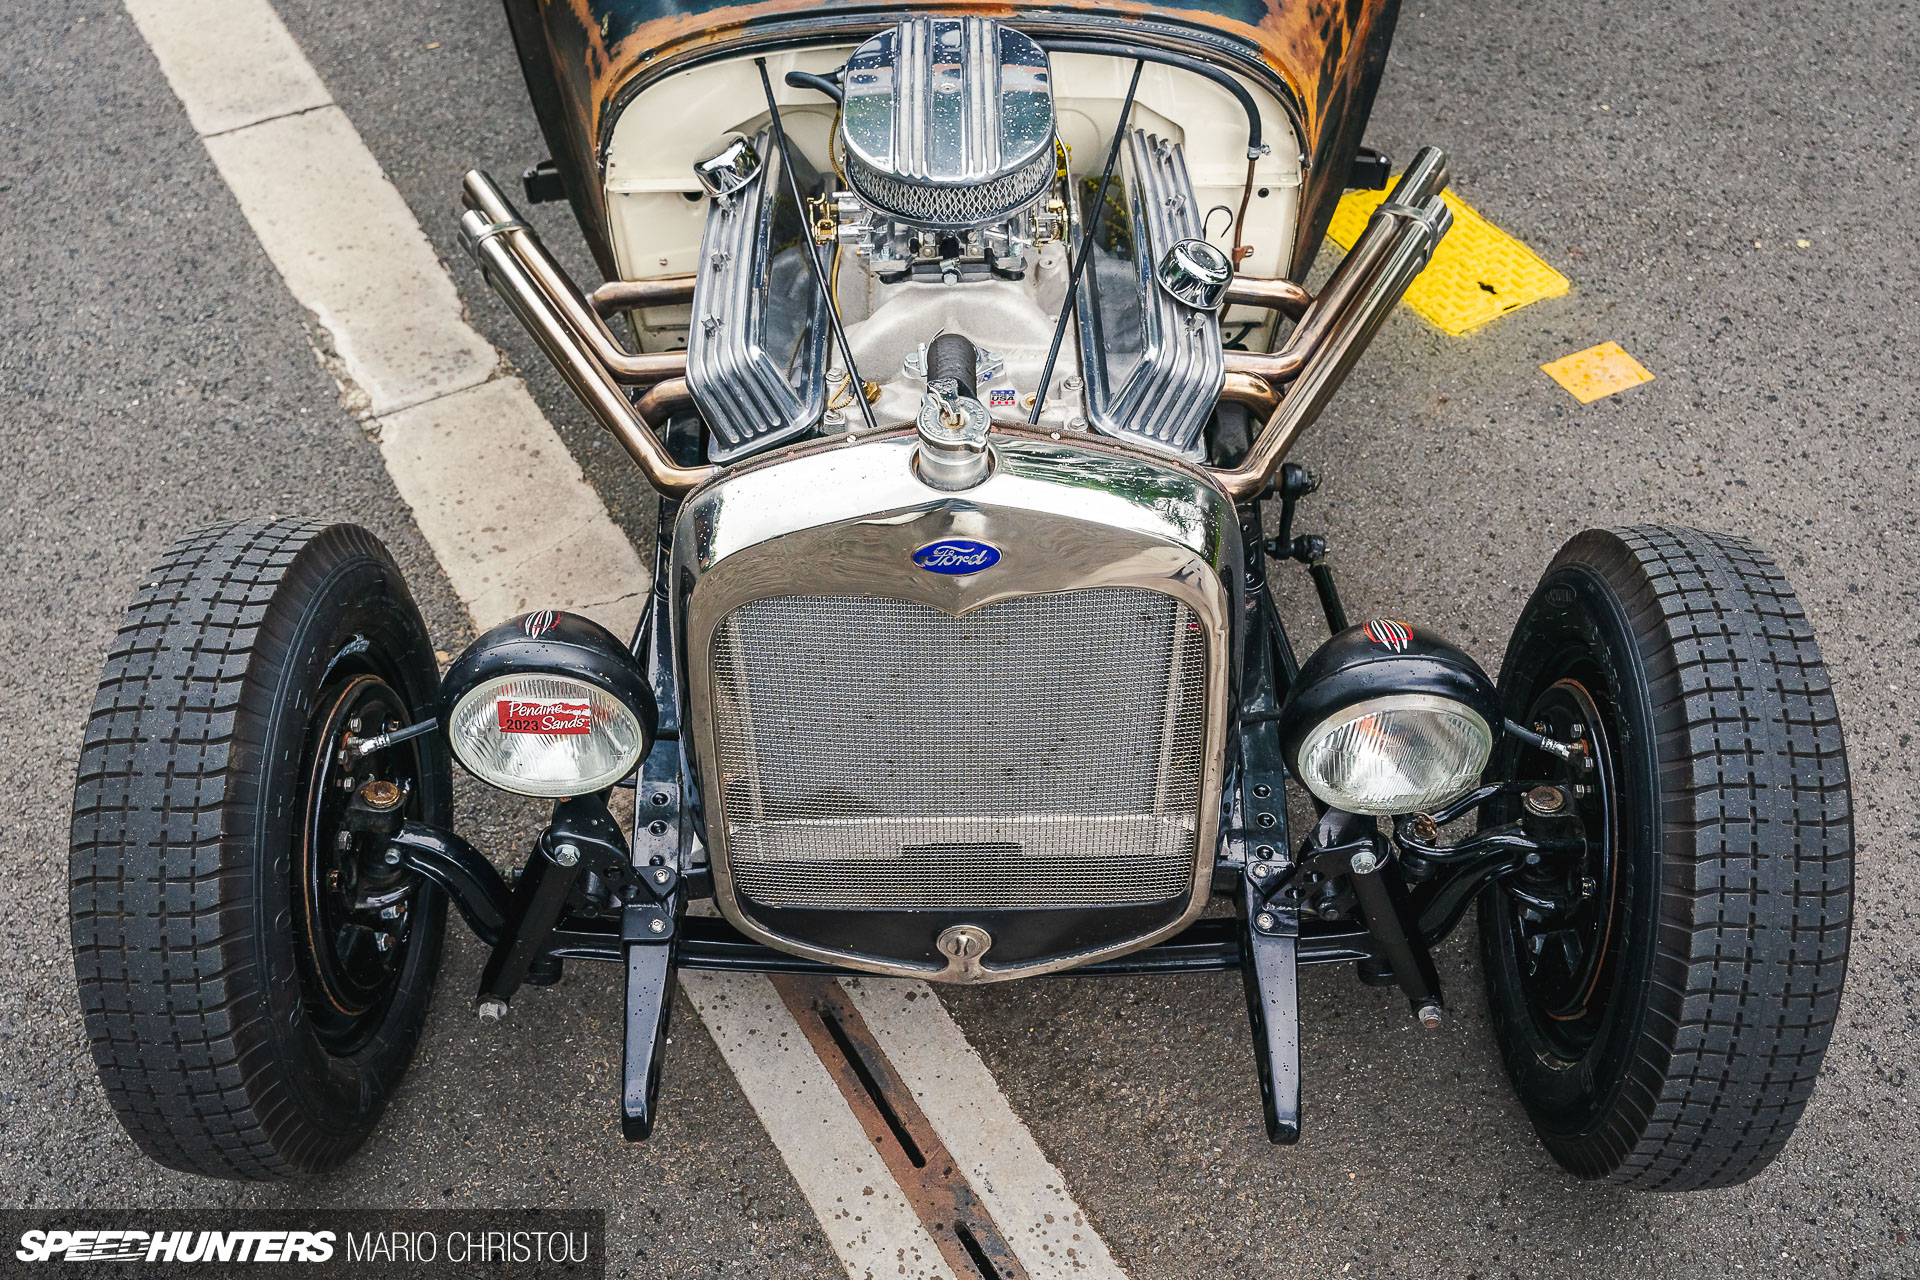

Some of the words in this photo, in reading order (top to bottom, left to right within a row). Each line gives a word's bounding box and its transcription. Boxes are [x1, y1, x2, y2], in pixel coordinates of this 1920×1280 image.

[925, 545, 987, 566] Ford
[508, 702, 562, 718] Pendine
[506, 719, 539, 731] 2023
[541, 716, 585, 731] Sands
